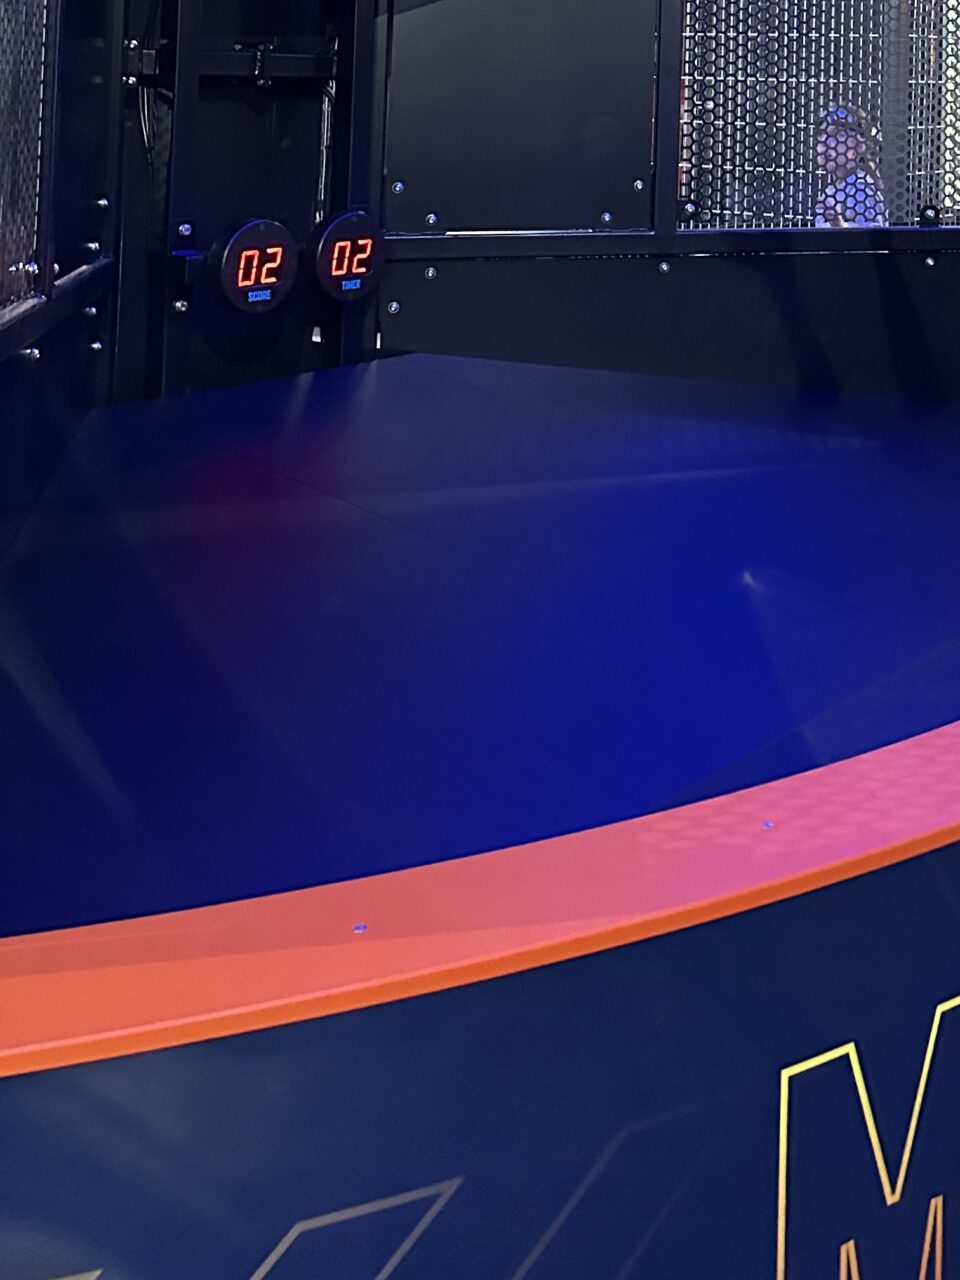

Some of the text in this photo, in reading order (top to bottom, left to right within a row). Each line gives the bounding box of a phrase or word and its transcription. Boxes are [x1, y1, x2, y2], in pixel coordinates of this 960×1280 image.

[238, 247, 283, 287] 02
[331, 238, 373, 276] 02
[248, 289, 271, 302] SCORE
[342, 279, 361, 291] TIMER
